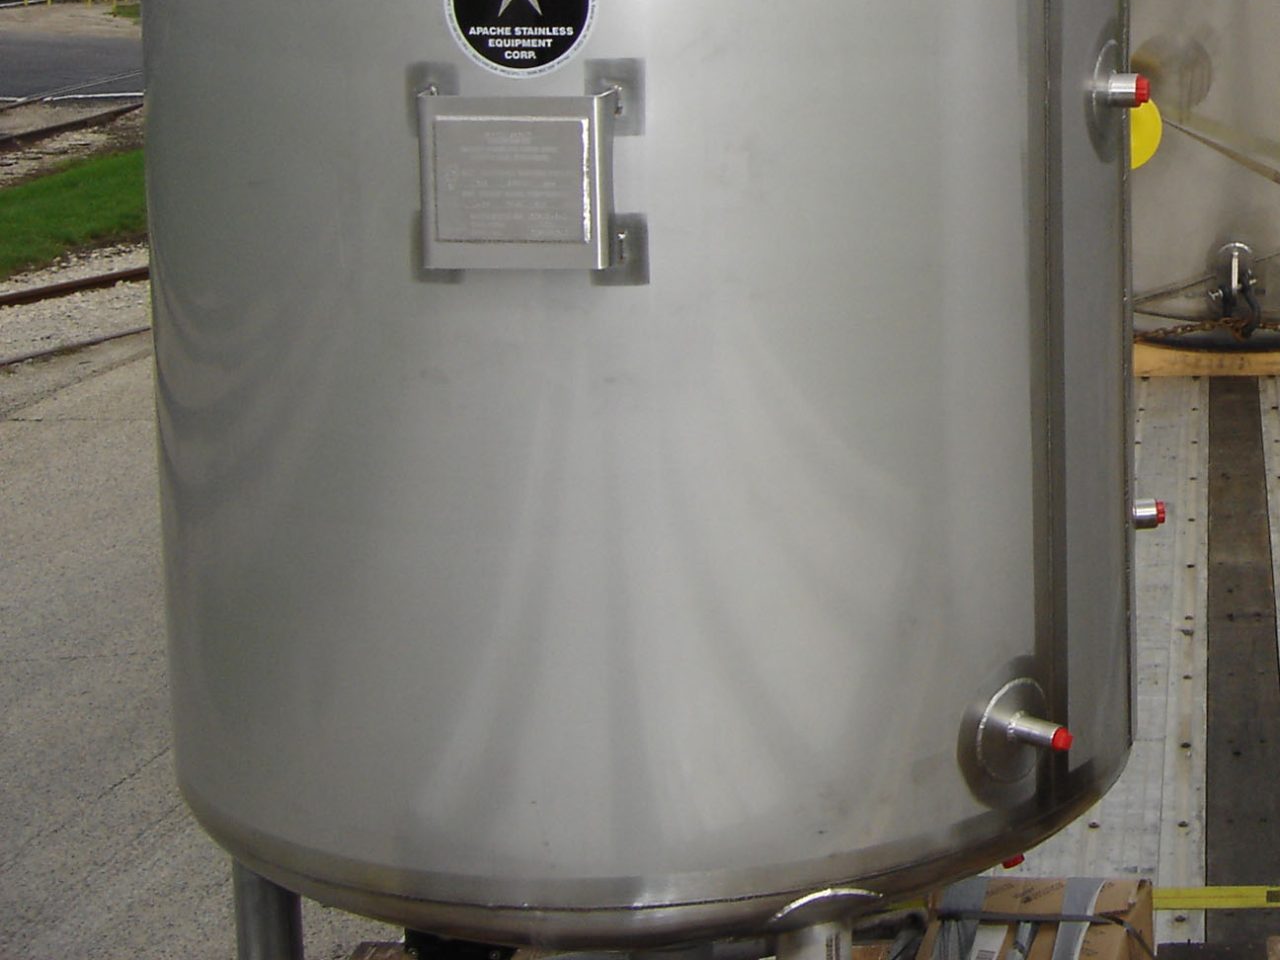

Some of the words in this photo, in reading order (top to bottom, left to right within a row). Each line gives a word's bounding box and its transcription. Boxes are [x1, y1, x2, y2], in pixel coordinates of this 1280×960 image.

[468, 26, 512, 36] APACHE
[514, 26, 574, 36] STAINLESS
[488, 38, 553, 48] EQUIPMENT
